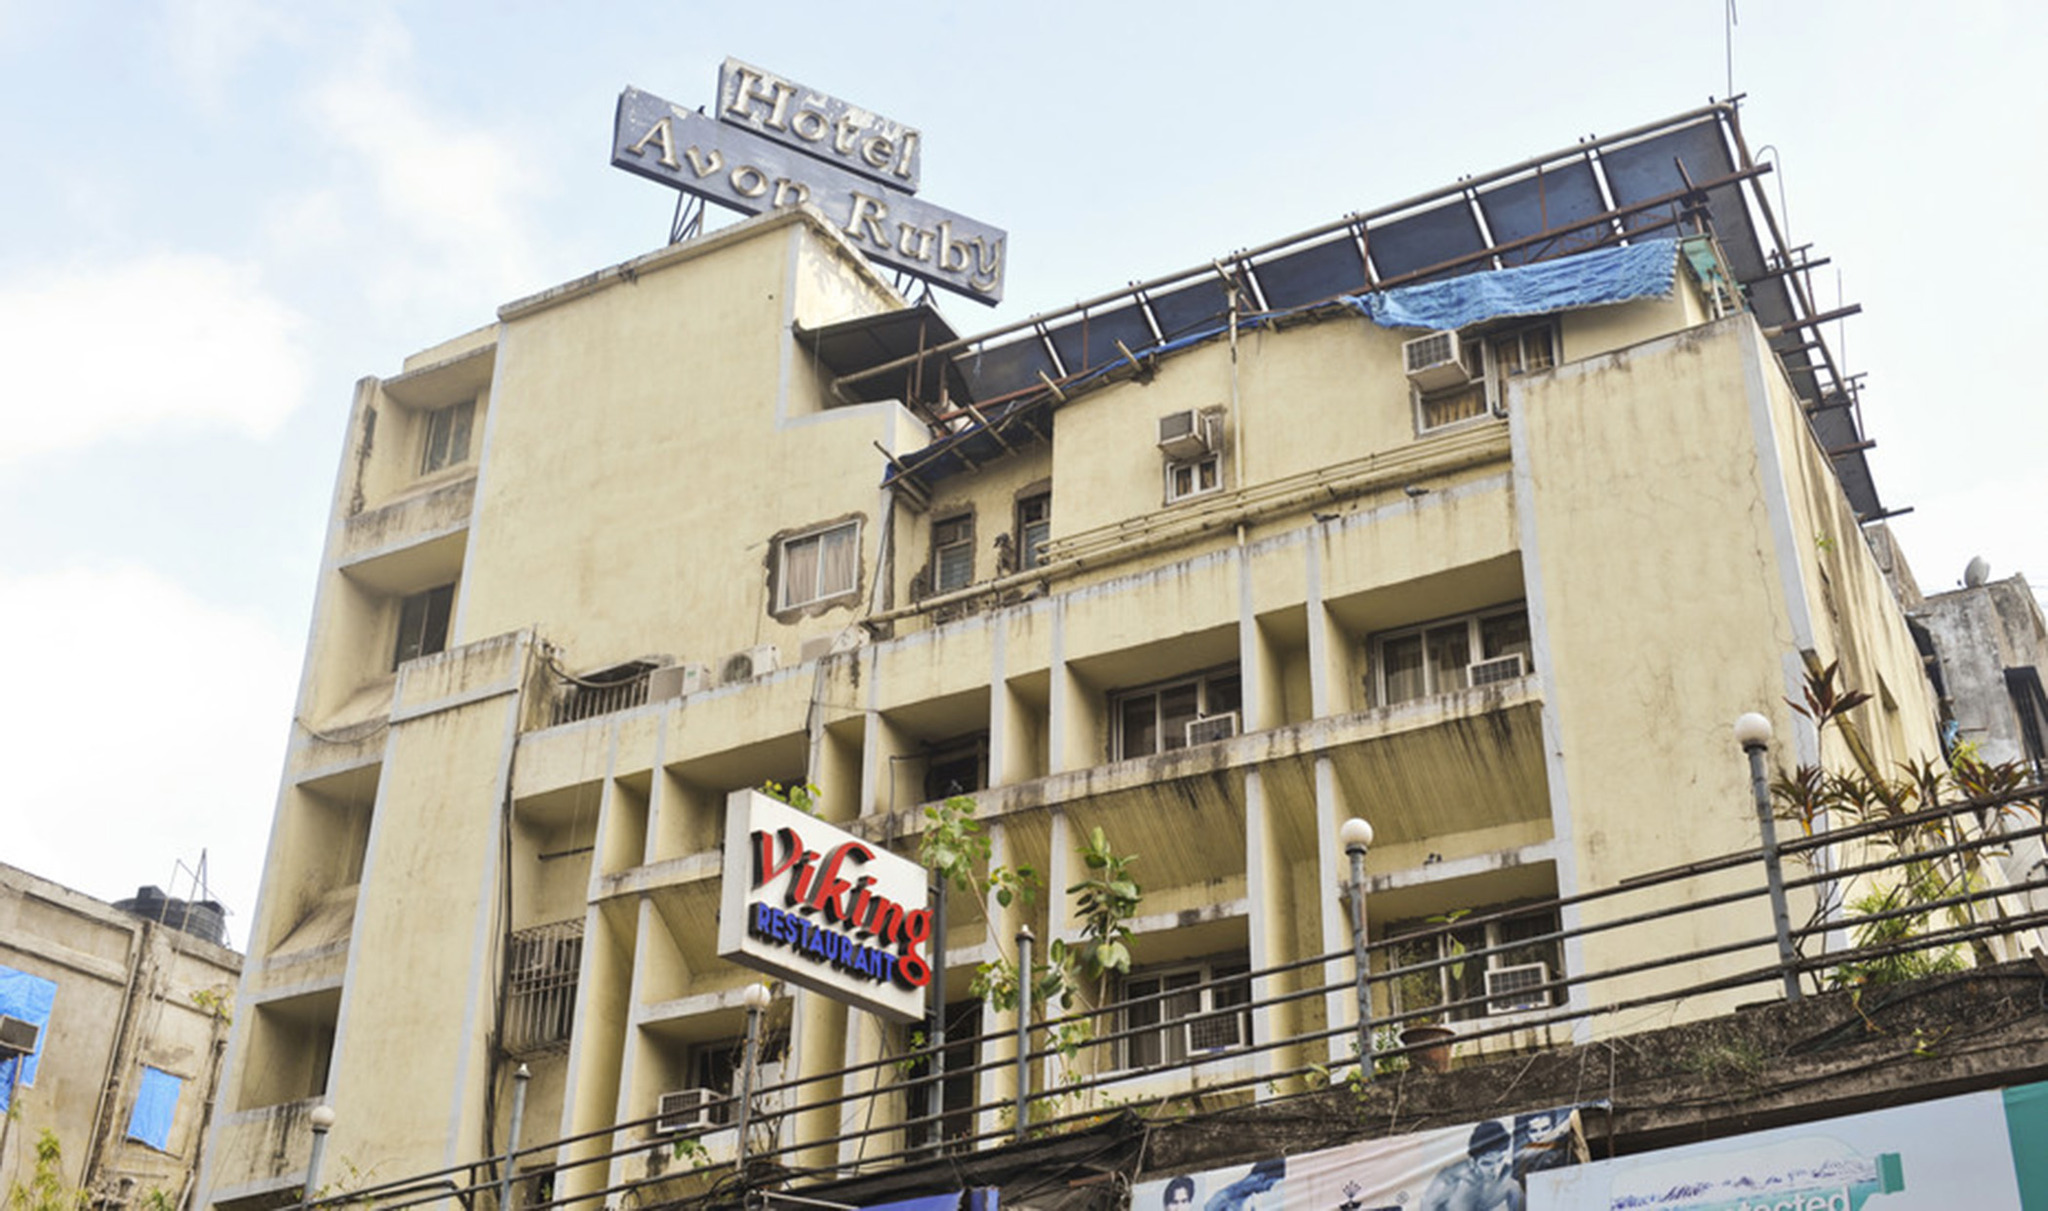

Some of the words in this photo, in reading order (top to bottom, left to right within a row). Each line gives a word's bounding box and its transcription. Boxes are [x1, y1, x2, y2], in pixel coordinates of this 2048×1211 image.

[726, 67, 919, 180] Hotel
[627, 116, 811, 210] Avon
[843, 190, 1003, 293] Ruby
[752, 827, 935, 988] Viking
[752, 902, 896, 983] RESTAURANT
